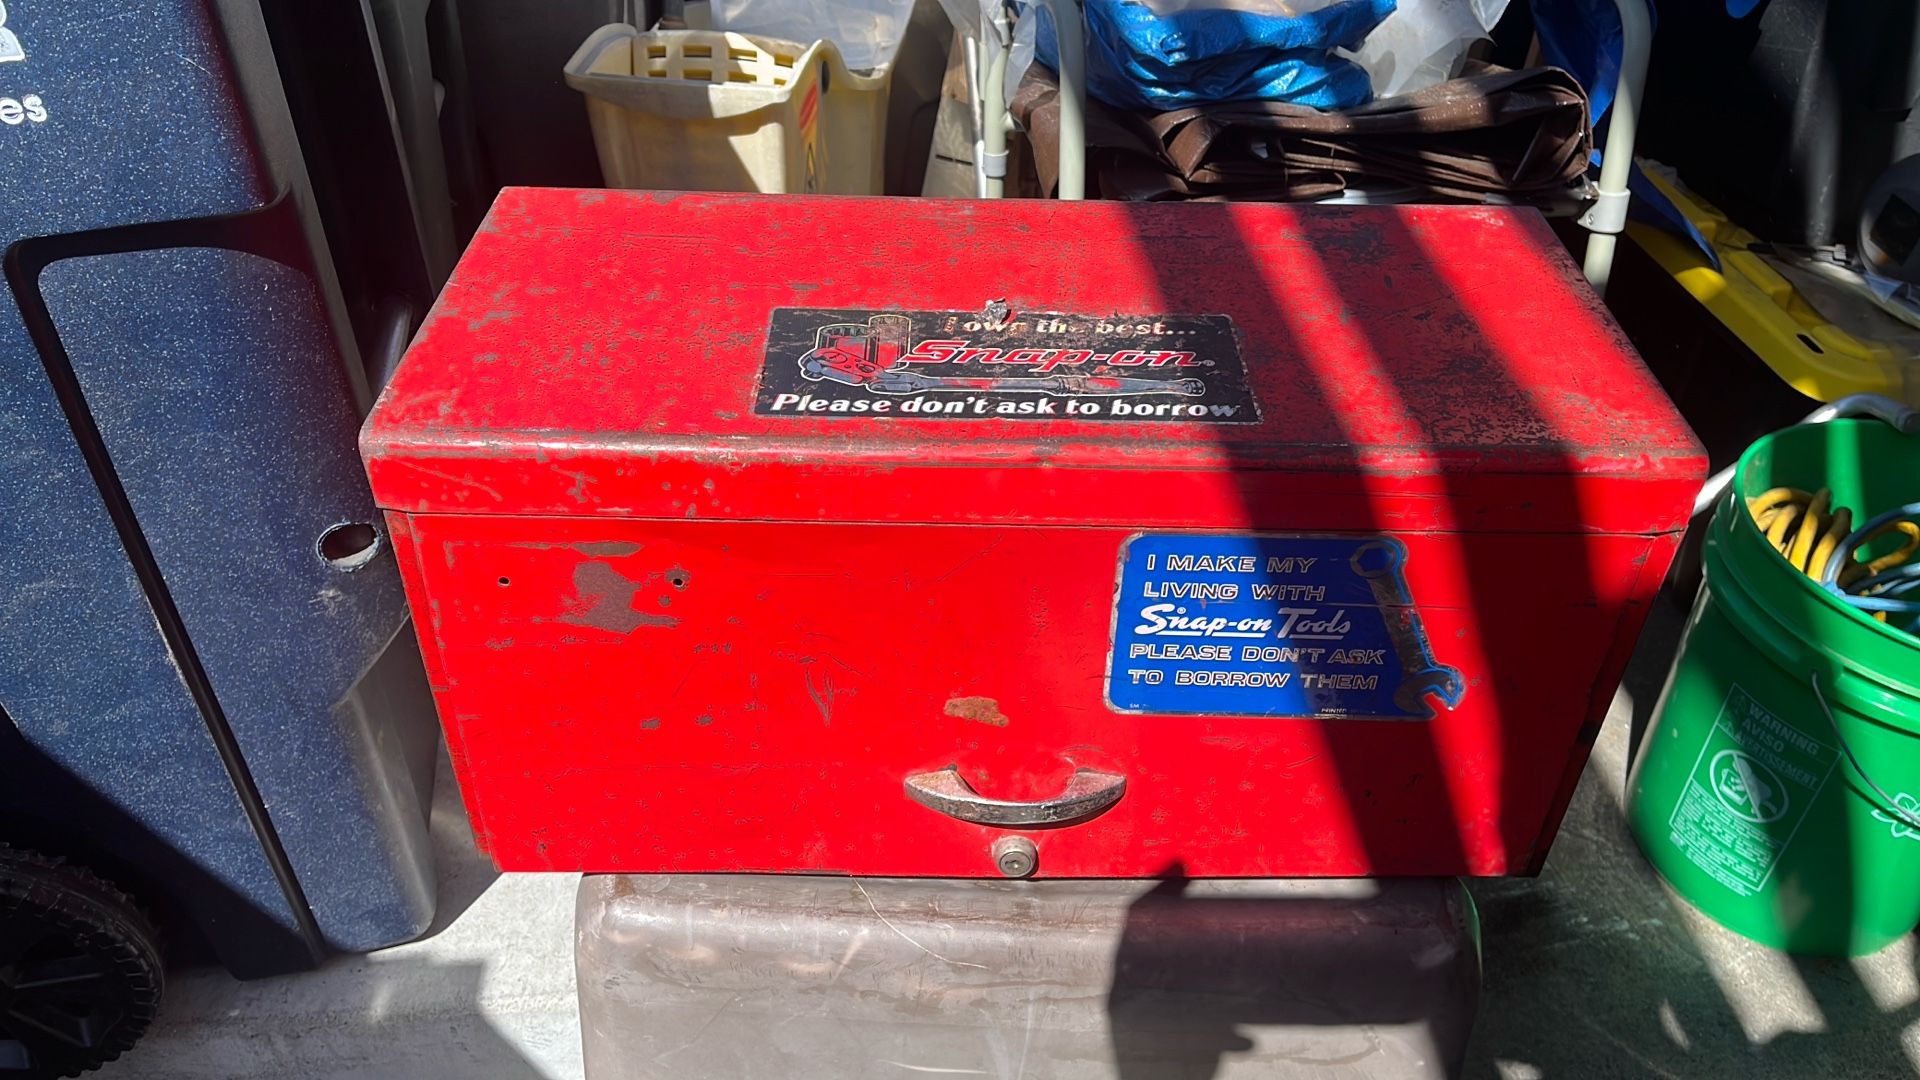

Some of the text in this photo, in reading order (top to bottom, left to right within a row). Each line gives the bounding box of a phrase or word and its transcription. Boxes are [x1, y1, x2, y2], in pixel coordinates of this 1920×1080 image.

[898, 339, 1206, 372] Snap-on
[771, 394, 1240, 418] Please don't ask to borrow
[1147, 554, 1319, 574] I MAKE MY
[1143, 581, 1326, 602] LIVING WITH
[1134, 603, 1351, 640] Snap-on Tools
[1129, 643, 1387, 665] PLEASE DON'T ASK
[1127, 669, 1379, 691] TO BORROW THEM
[1742, 718, 1785, 753] AVISO
[1749, 702, 1820, 756] WARNING
